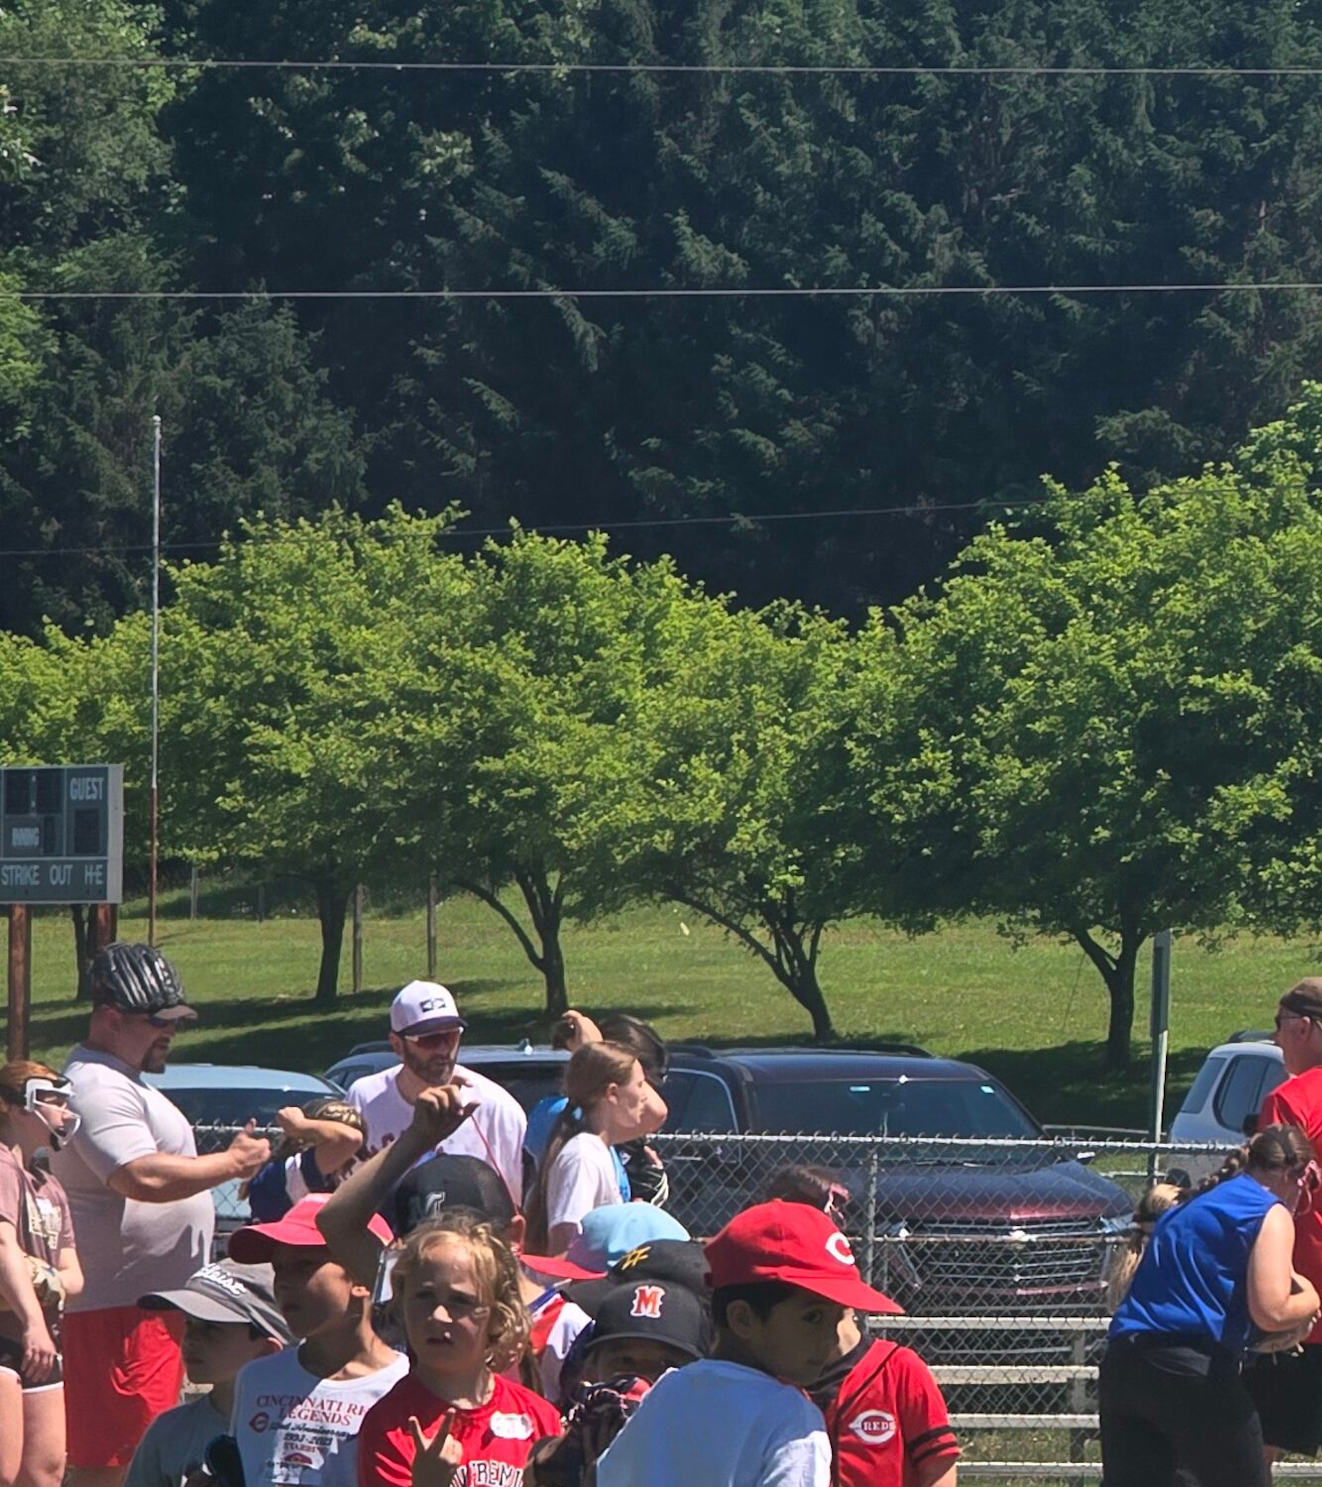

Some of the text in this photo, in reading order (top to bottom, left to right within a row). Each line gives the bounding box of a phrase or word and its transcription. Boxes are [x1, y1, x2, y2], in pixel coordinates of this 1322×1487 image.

[69, 777, 104, 800] GUEST
[1, 864, 40, 886] STRIKE
[49, 863, 73, 885] OUT
[825, 1231, 855, 1266] C
[630, 1285, 665, 1318] M
[256, 1395, 341, 1411] CINCINNATI
[279, 1407, 352, 1427] LEGENDS
[863, 1421, 896, 1432] REDS
